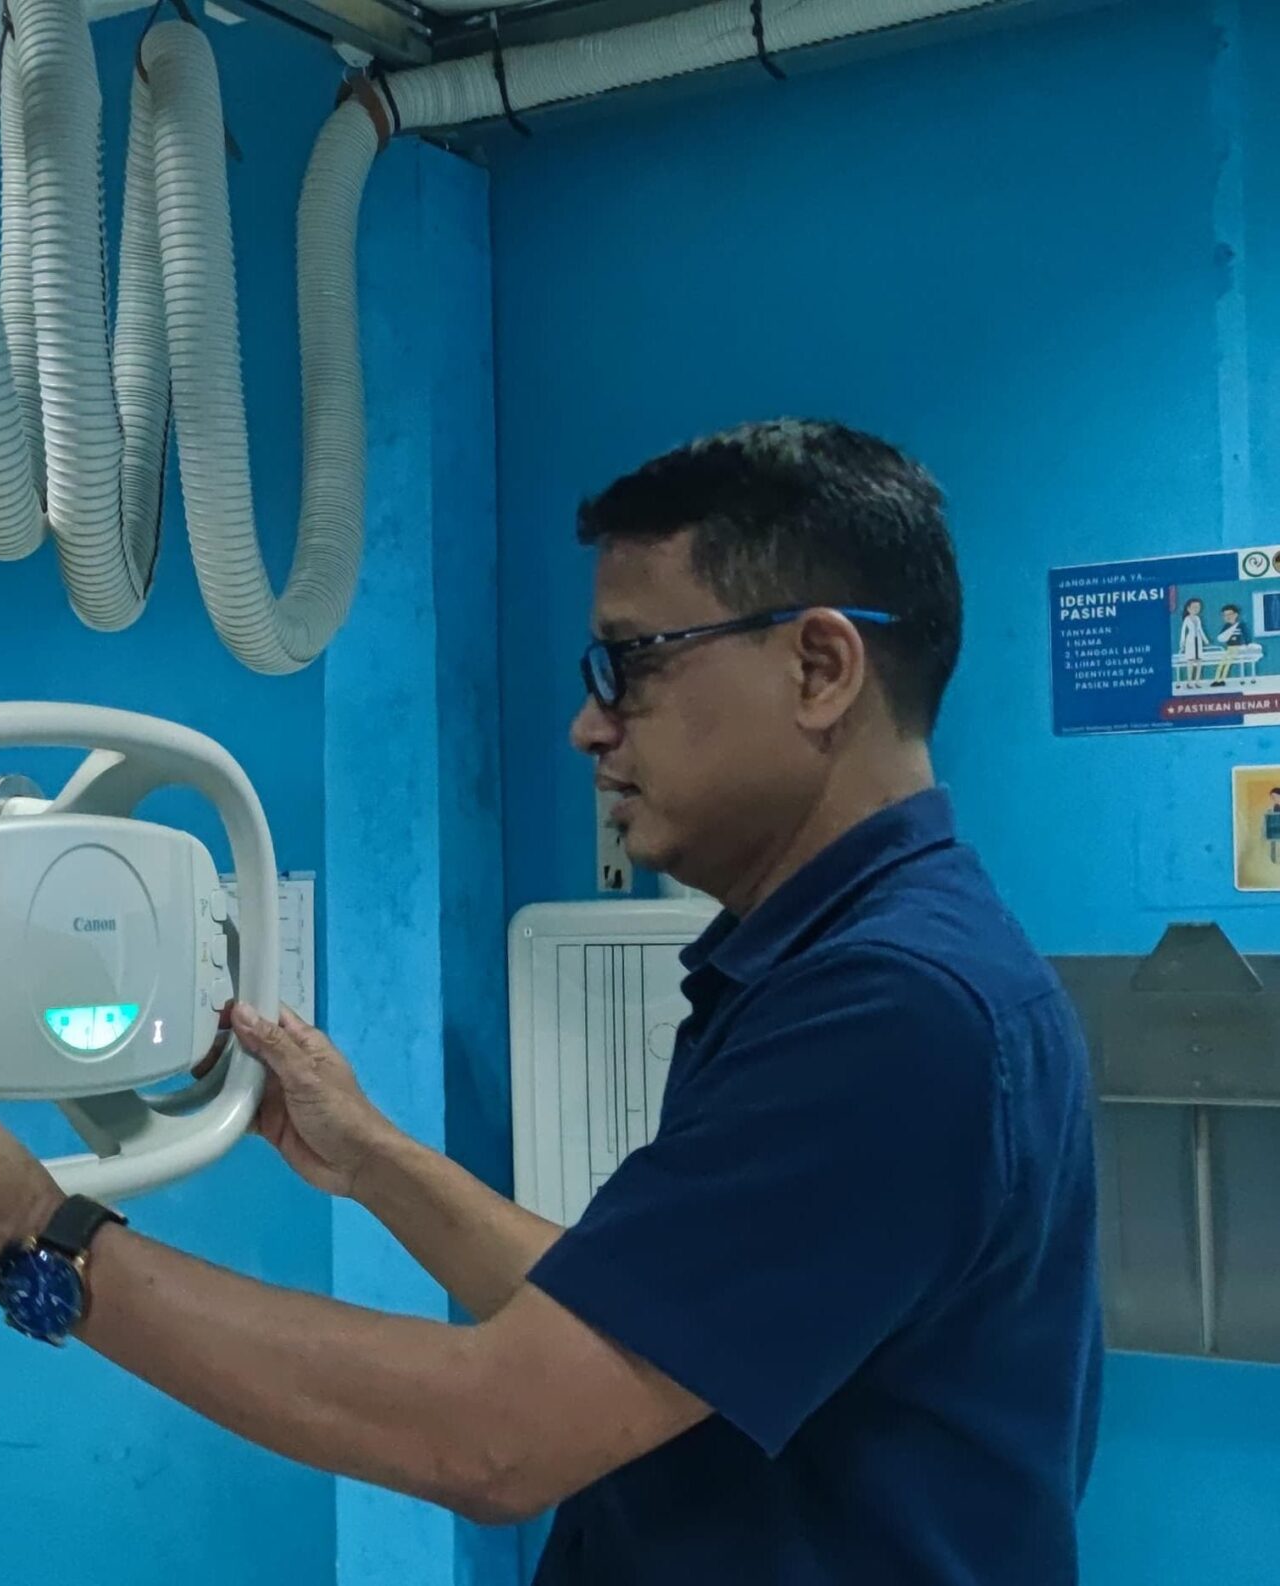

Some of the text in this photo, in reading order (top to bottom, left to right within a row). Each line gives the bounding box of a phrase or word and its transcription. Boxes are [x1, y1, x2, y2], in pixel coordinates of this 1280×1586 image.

[1059, 577, 1098, 588] JANGAN
[1103, 575, 1126, 584] LUPA
[1060, 587, 1164, 608] IDENTIFIKASI
[1060, 605, 1116, 620] PASIEN
[1061, 626, 1112, 637] TANYAKAN
[1074, 638, 1102, 647] NAMA
[1123, 644, 1151, 654] LAHIR
[1075, 666, 1154, 679] IDENTITAS PADA
[1075, 681, 1109, 691] PASIEN
[1177, 703, 1231, 714] PASTIKAN
[1234, 700, 1270, 711] BENAR
[73, 917, 116, 931] Canon
